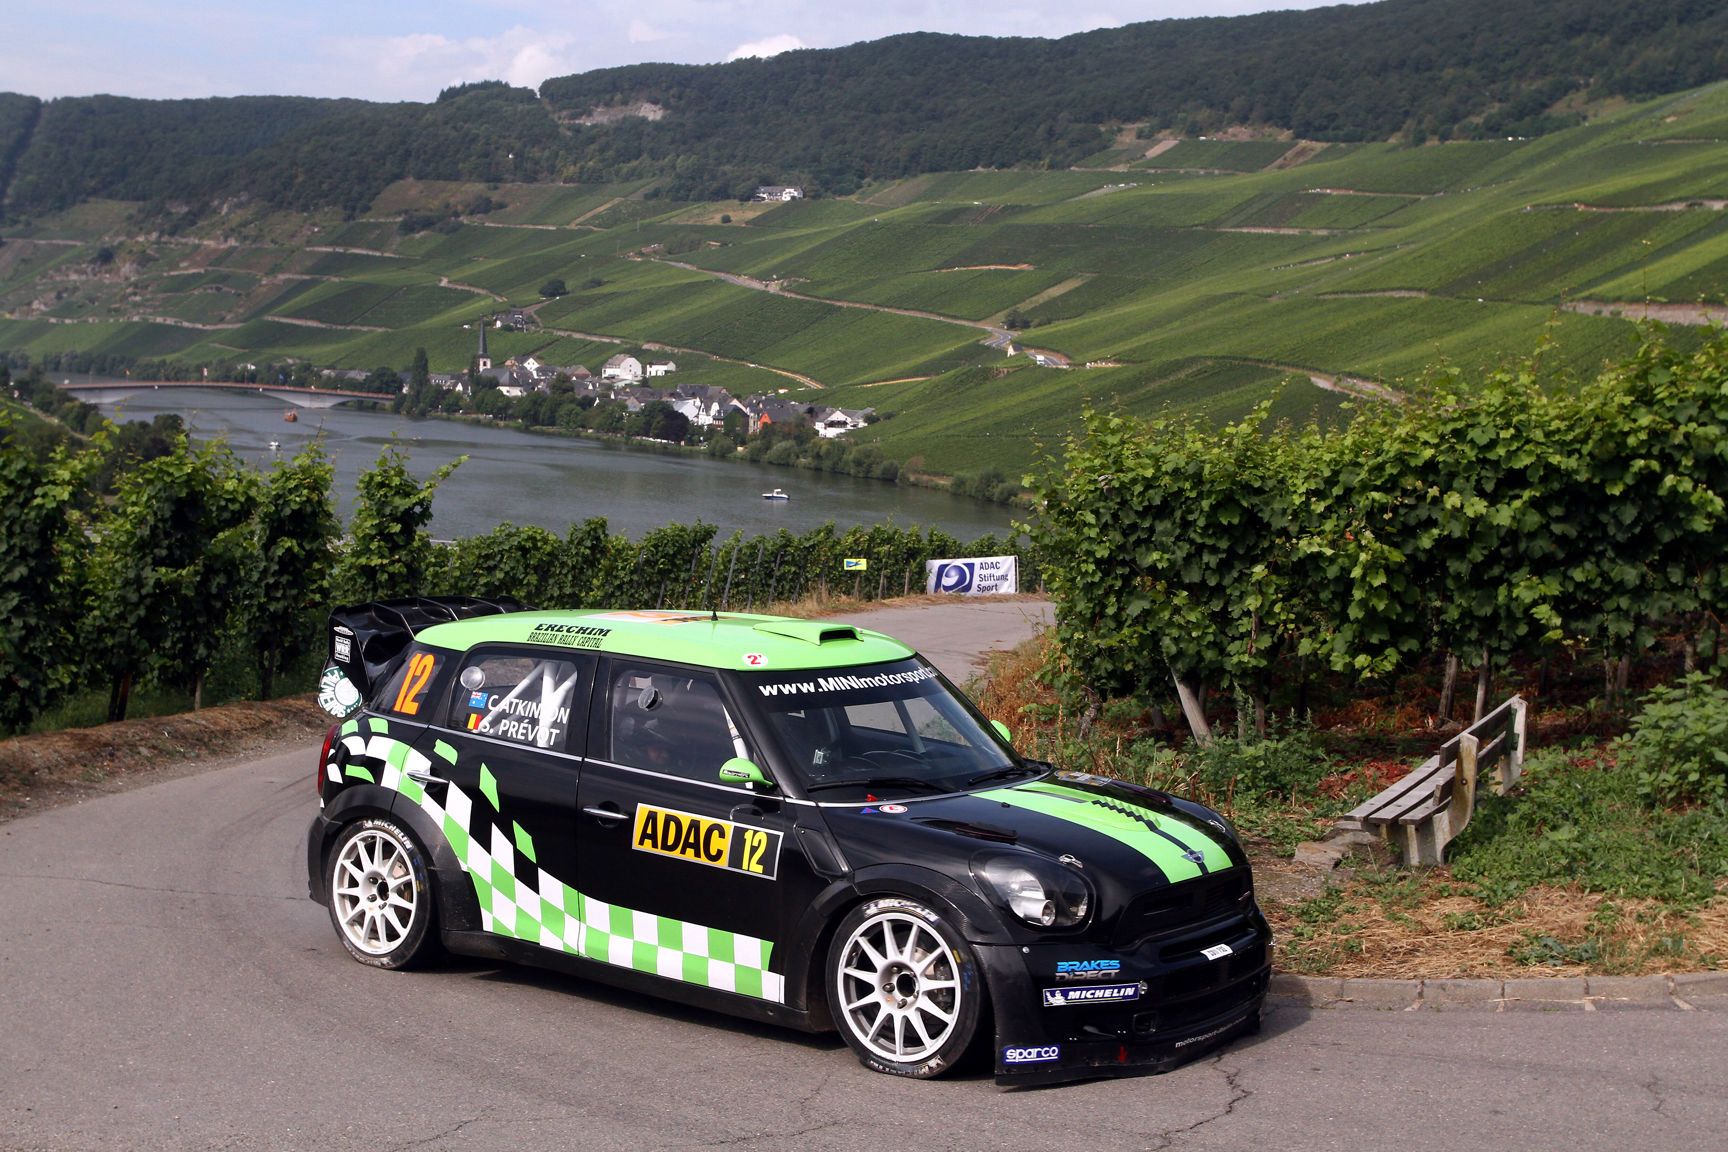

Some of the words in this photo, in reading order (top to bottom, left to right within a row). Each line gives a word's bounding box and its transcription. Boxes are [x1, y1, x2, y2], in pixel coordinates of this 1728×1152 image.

[979, 561, 1000, 571] ADAC
[978, 573, 1008, 582] Stiftung
[976, 583, 998, 593] Sport
[534, 623, 612, 637] ERECHIM
[527, 632, 559, 644] BRAZILIAN
[557, 634, 579, 646] RALLY
[576, 636, 603, 648] CAPITAL
[393, 653, 436, 715] 12
[500, 698, 570, 724] ATKINON
[373, 820, 414, 850] MICHELIN
[638, 810, 726, 863] ADAC
[742, 829, 768, 874] 12
[1057, 959, 1121, 972] BRAKES
[1067, 986, 1136, 1000] MICHELIN
[1006, 1046, 1059, 1063] sparco
